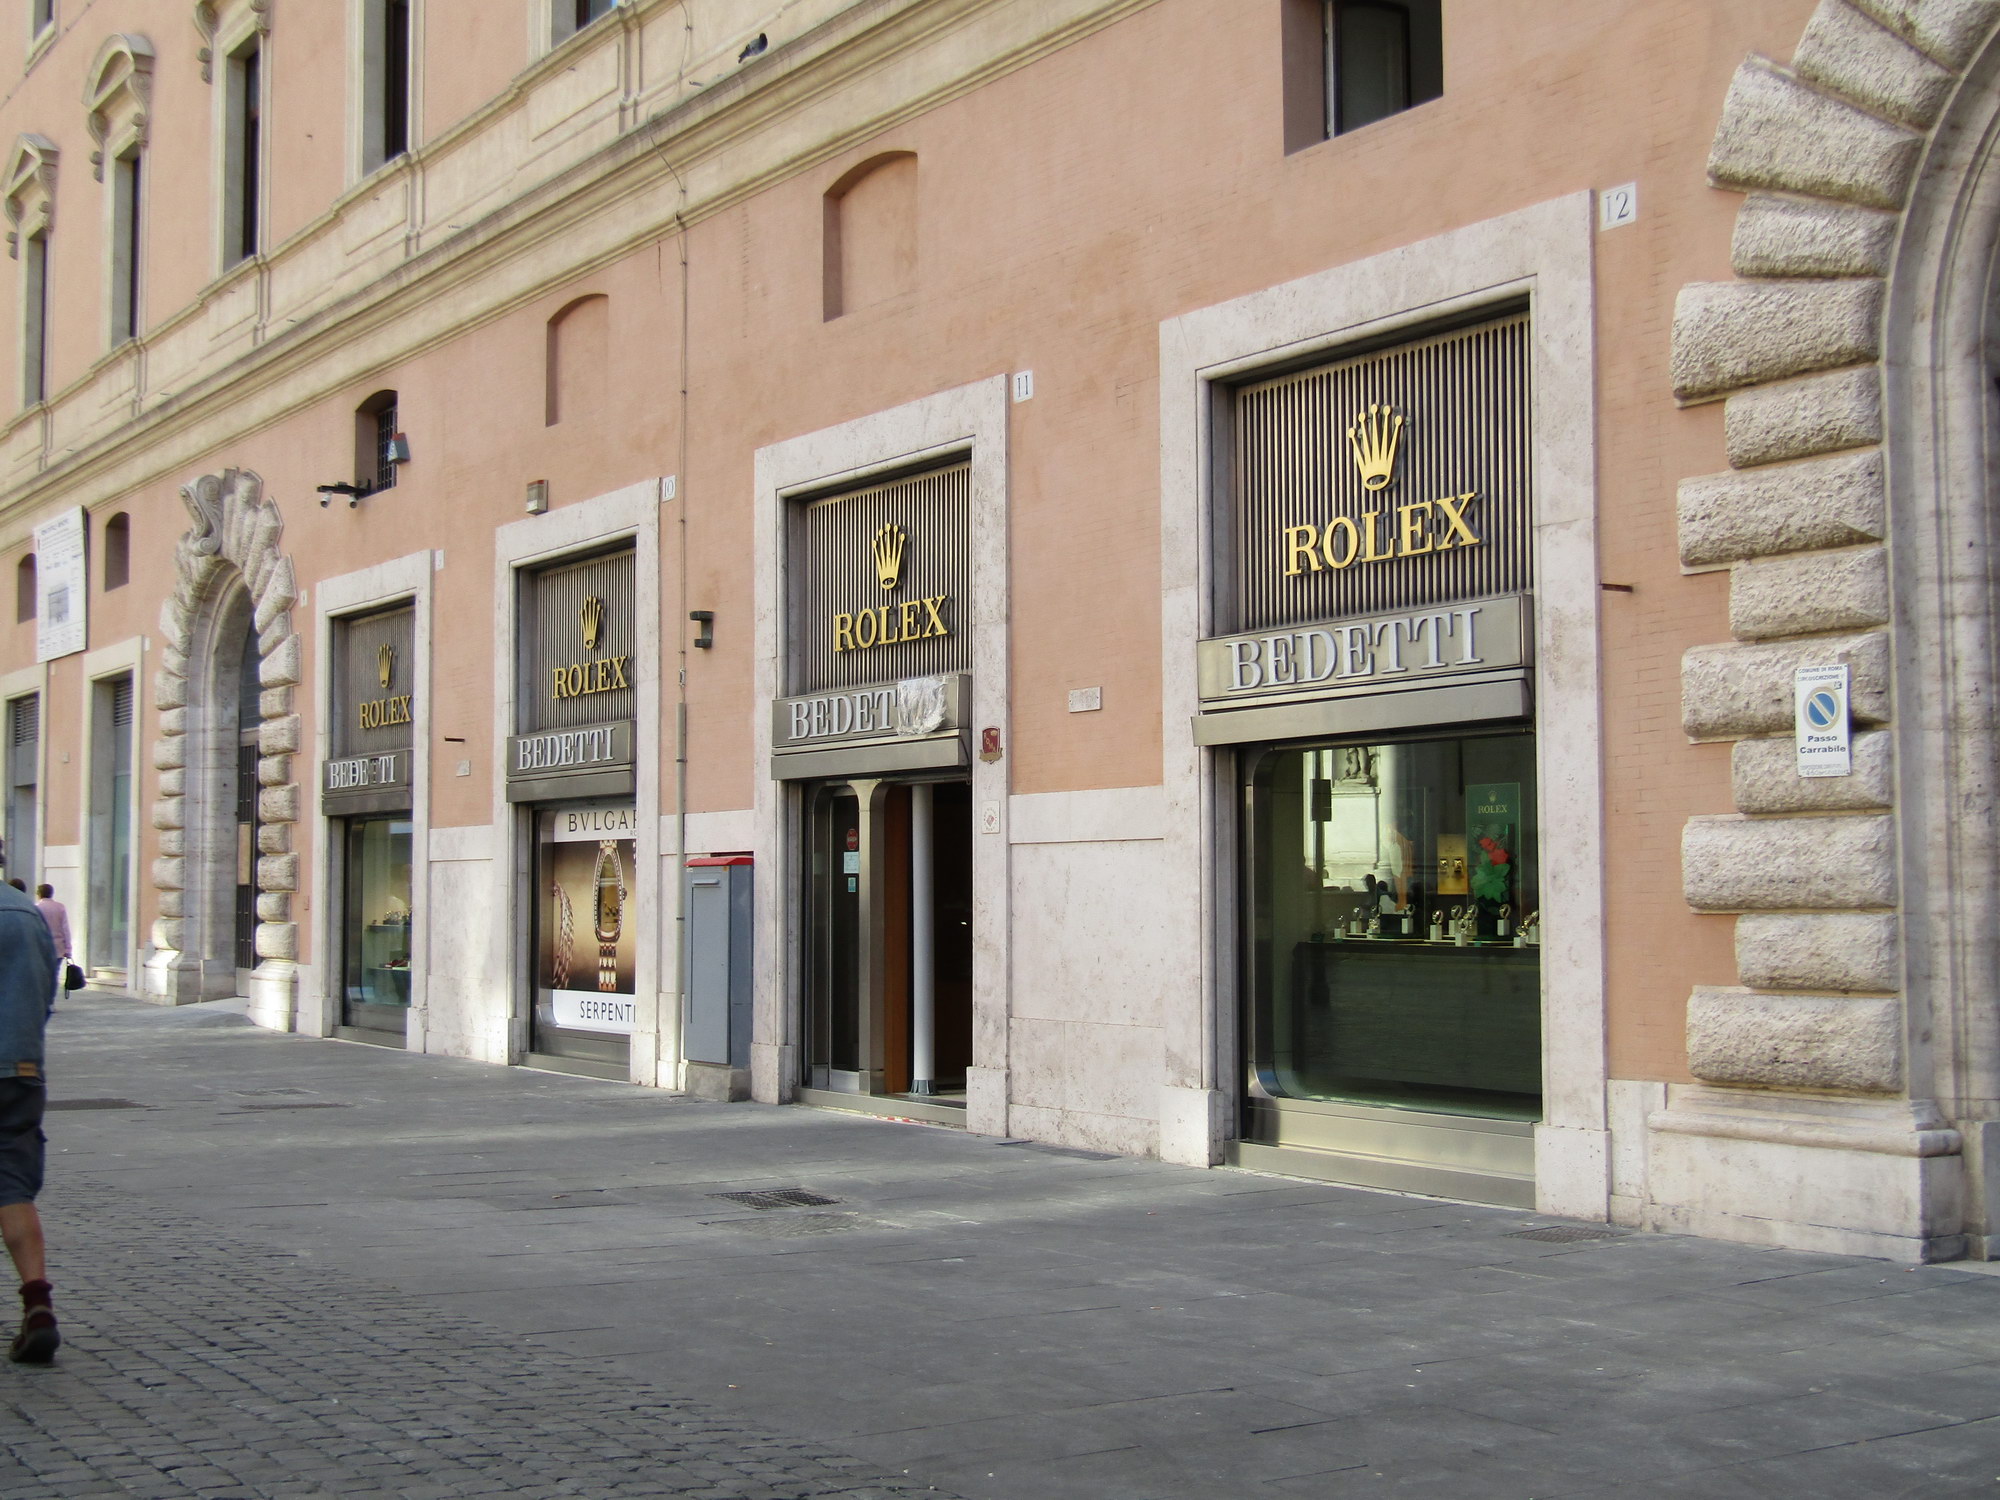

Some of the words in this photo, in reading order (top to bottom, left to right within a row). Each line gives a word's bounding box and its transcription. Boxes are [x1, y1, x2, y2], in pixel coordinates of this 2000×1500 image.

[1605, 191, 1630, 222] 12
[1017, 375, 1028, 397] 11
[664, 479, 674, 498] 10
[1285, 492, 1481, 576] ROLEX
[834, 596, 949, 652] ROLEX
[1225, 608, 1484, 691] BEDETTI
[552, 656, 628, 699] ROLEX
[360, 695, 412, 728] ROLEX
[788, 689, 898, 740] BEDET
[517, 727, 615, 770] BEDETTI
[1799, 745, 1846, 754] Carrabile
[1807, 735, 1838, 743] Passo
[1478, 804, 1508, 814] ROLEX
[580, 1000, 636, 1023] SERPENTI
